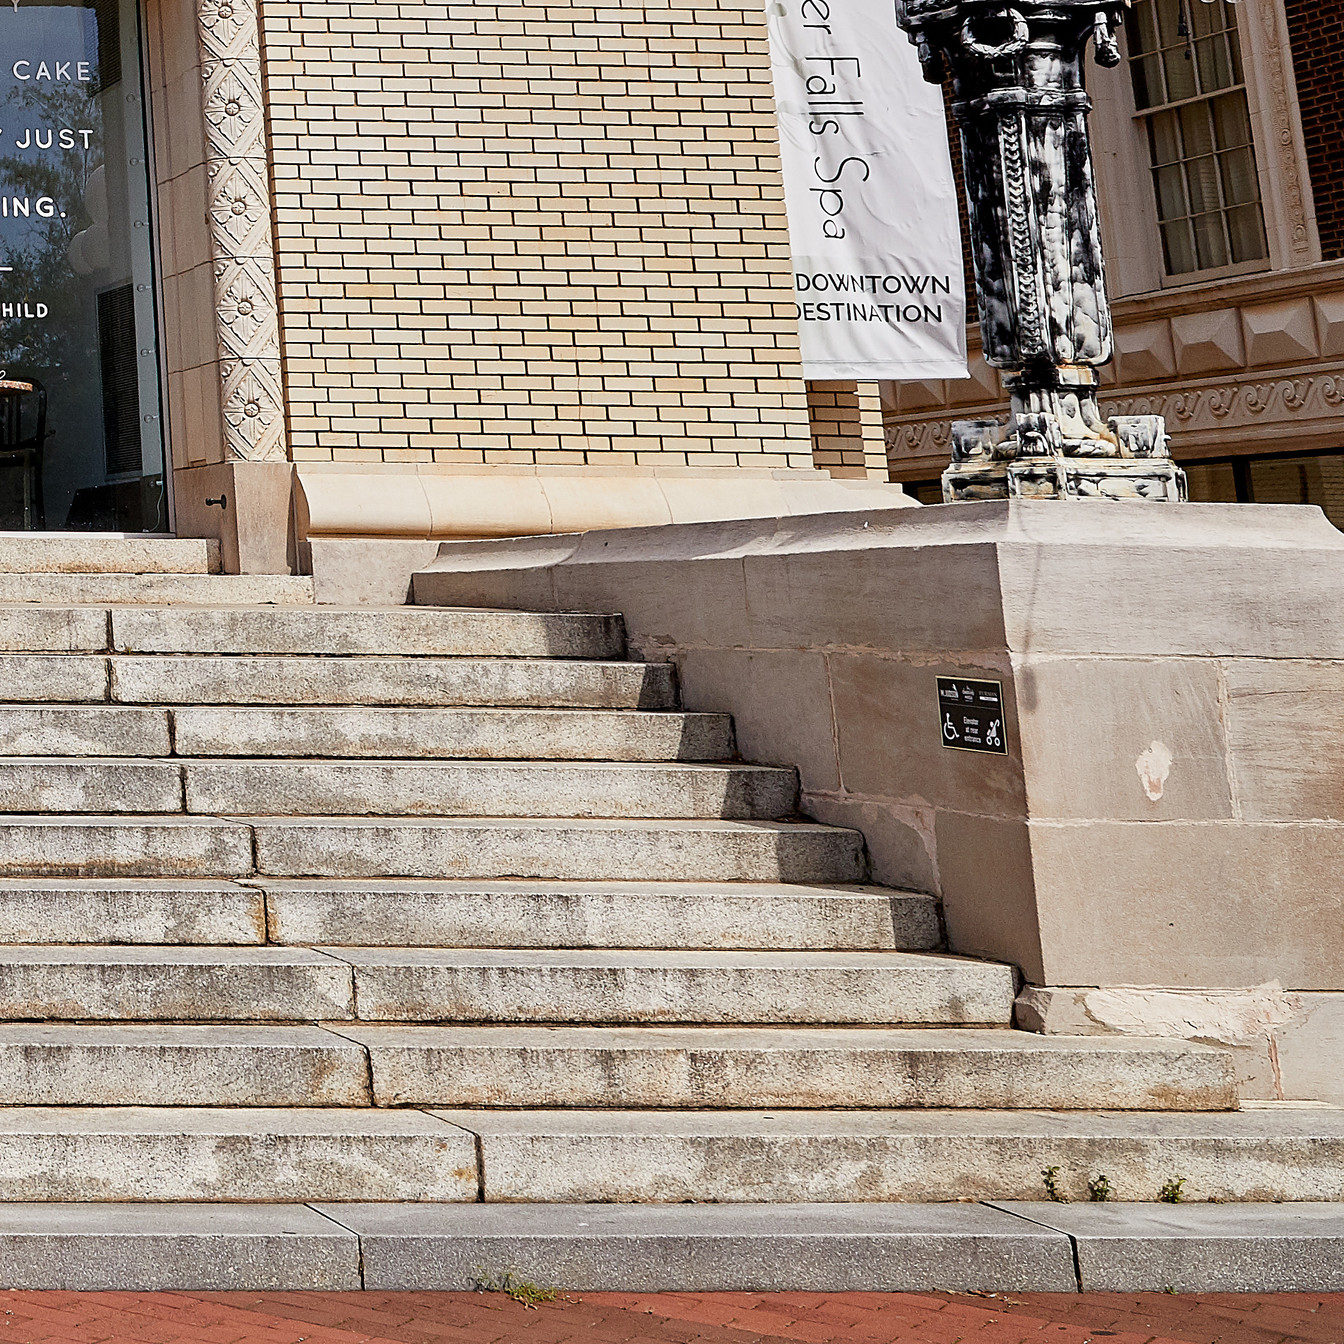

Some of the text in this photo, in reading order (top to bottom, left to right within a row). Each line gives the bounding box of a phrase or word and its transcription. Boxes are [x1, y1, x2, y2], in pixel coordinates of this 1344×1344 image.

[12, 60, 91, 82] CAKE
[804, 56, 865, 136] Falls
[15, 128, 95, 150] JUST
[809, 156, 870, 241] Spa
[795, 273, 951, 294] DOWNTOWN
